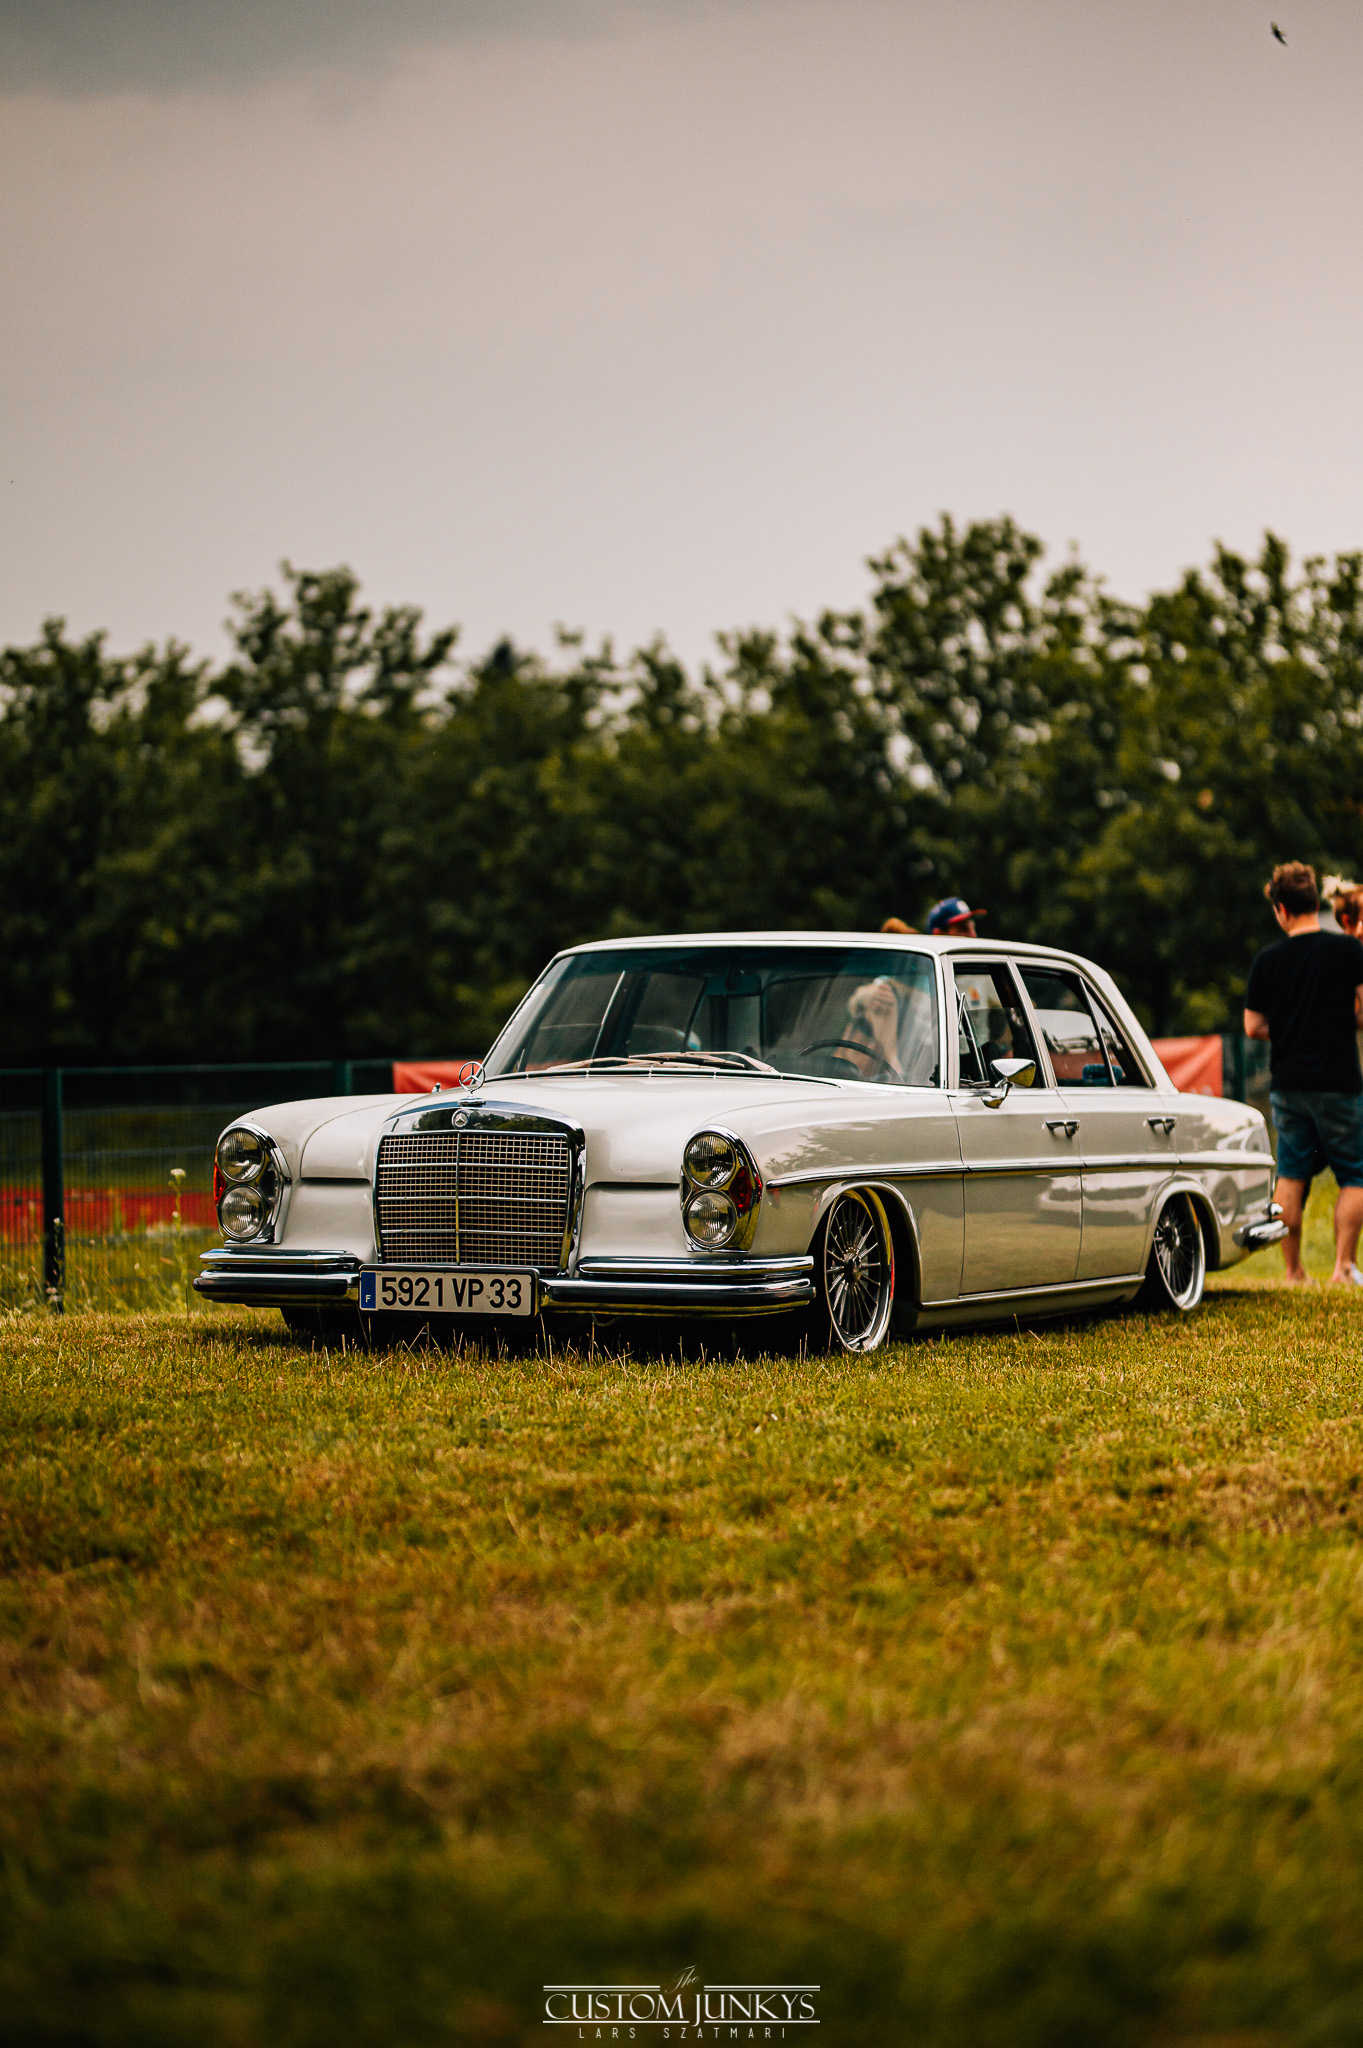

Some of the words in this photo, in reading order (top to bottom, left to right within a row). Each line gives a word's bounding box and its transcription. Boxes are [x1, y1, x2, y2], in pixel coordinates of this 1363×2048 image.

[365, 1294, 371, 1303] F
[381, 1276, 444, 1307] 5921
[452, 1278, 484, 1308] VP
[489, 1278, 522, 1309] 33
